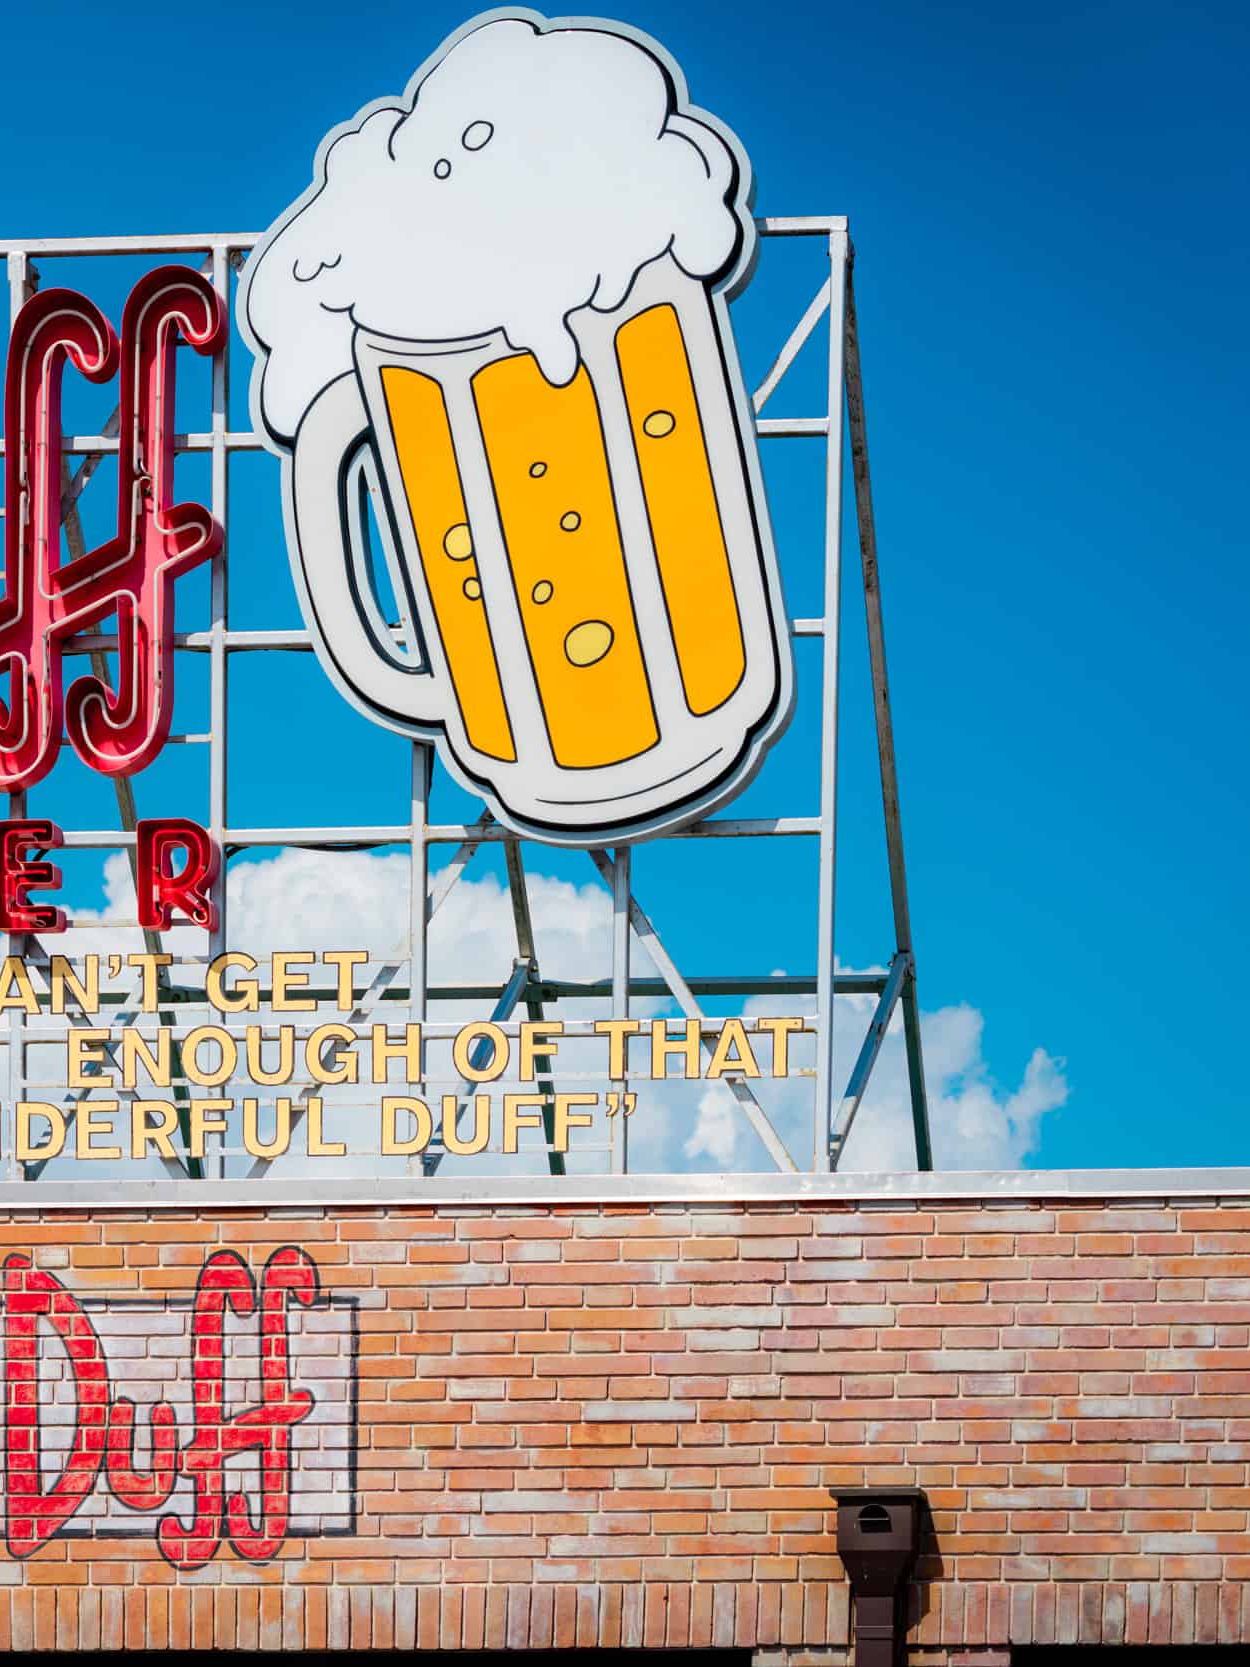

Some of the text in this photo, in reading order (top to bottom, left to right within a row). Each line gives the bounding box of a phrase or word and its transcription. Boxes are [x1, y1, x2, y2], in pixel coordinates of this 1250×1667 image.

[205, 950, 369, 1013] GET
[67, 1016, 805, 1088] ENOUGH OF THAT
[381, 1092, 638, 1156] DUFF”
[3, 1245, 320, 1570] Duff
